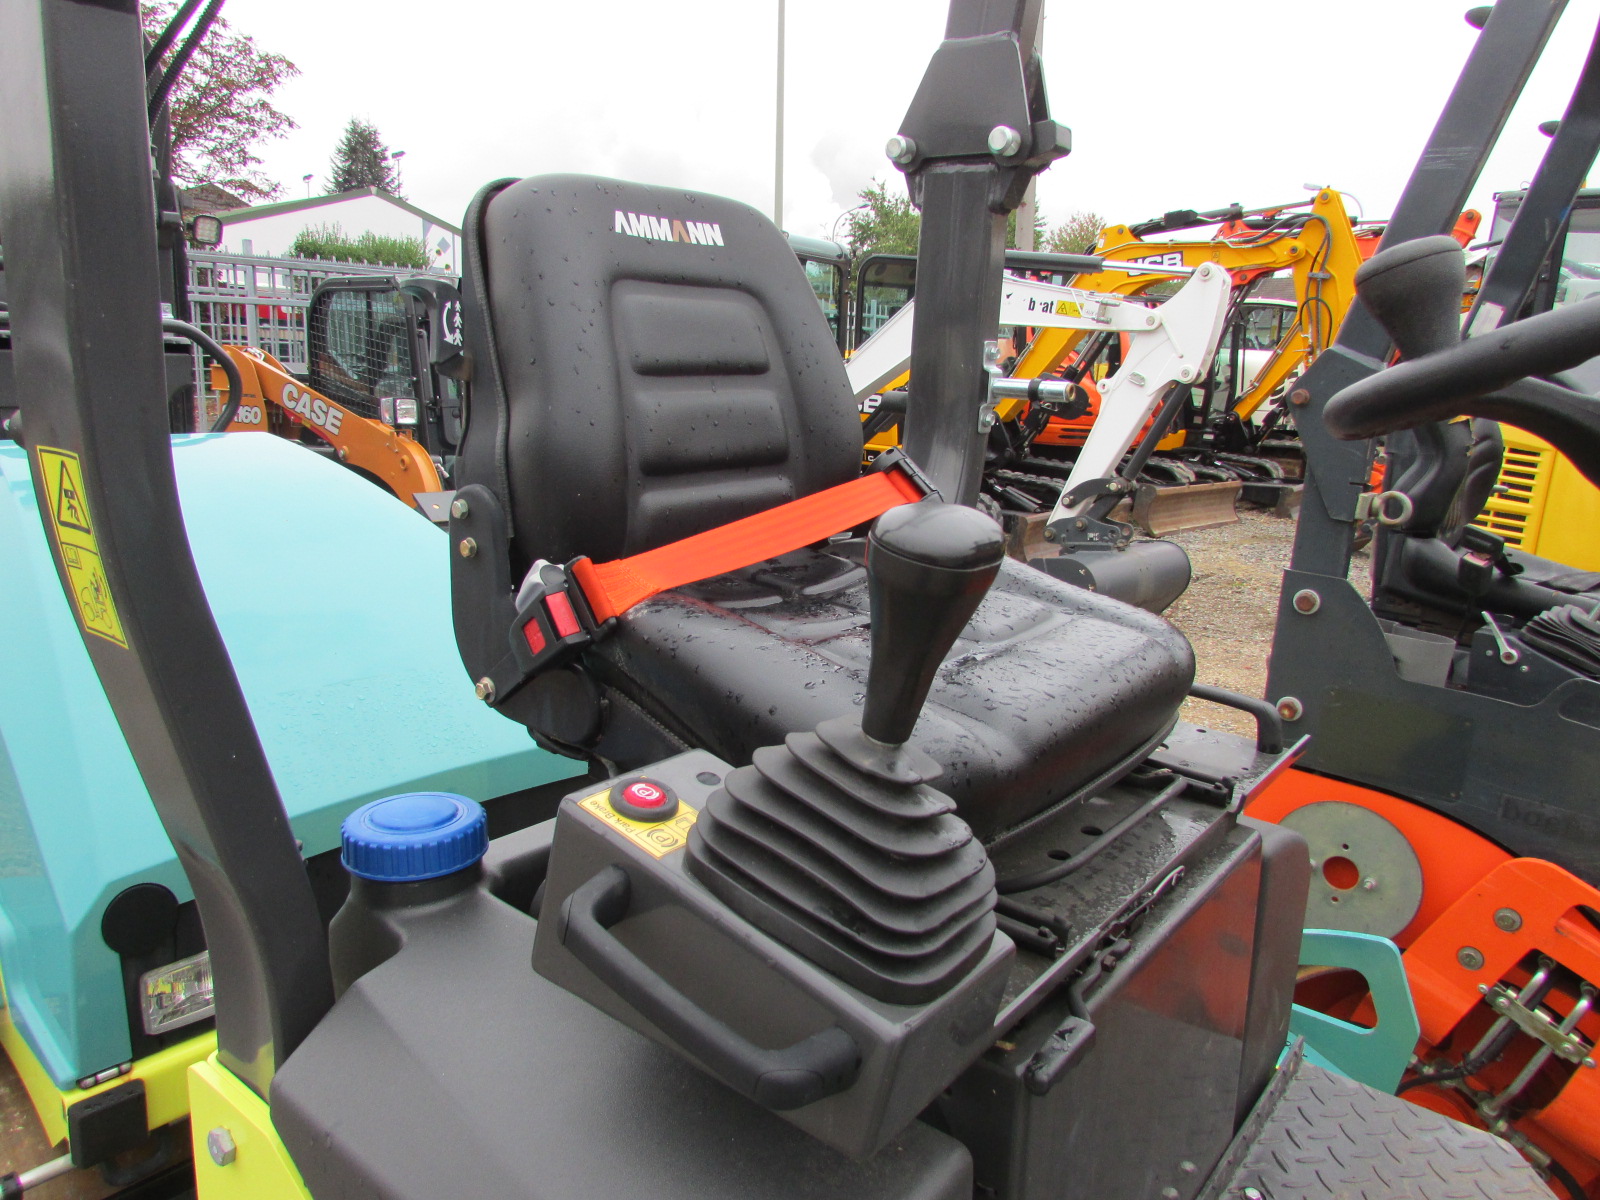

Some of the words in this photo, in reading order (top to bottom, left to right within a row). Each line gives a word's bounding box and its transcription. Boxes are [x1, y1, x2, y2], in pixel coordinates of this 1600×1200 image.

[615, 210, 724, 246] AMMANN
[282, 383, 344, 436] CASE
[590, 800, 616, 820] Brake
[616, 817, 636, 834] Park
